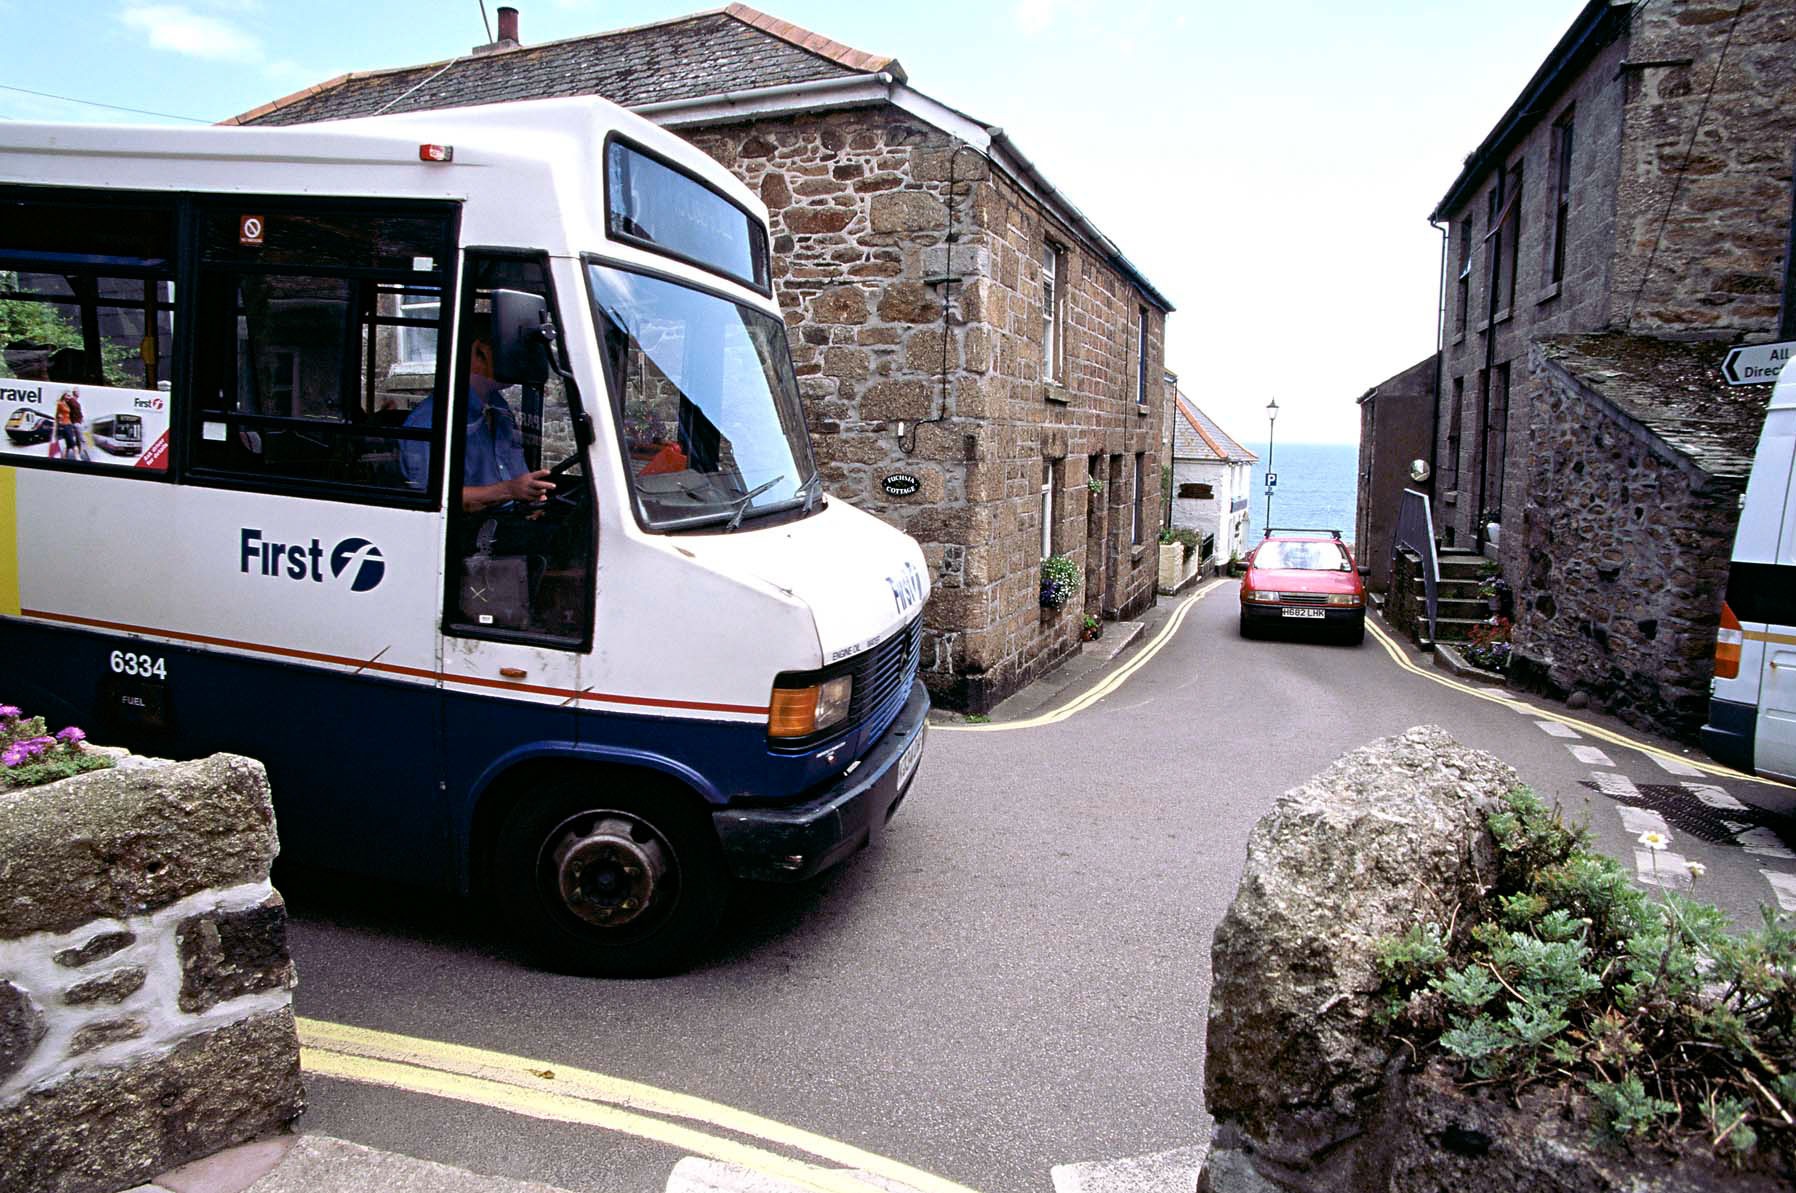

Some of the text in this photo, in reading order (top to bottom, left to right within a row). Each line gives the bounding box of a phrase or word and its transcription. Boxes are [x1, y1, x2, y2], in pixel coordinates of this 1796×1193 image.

[1769, 348, 1789, 361] All
[1744, 364, 1785, 378] Direc
[134, 397, 152, 408] First
[887, 475, 915, 484] FUCHSIA
[1267, 474, 1276, 486] P
[886, 486, 916, 495] COTTAGE
[240, 528, 324, 583] First
[110, 650, 167, 680] 6334
[121, 695, 146, 707] FUEL
